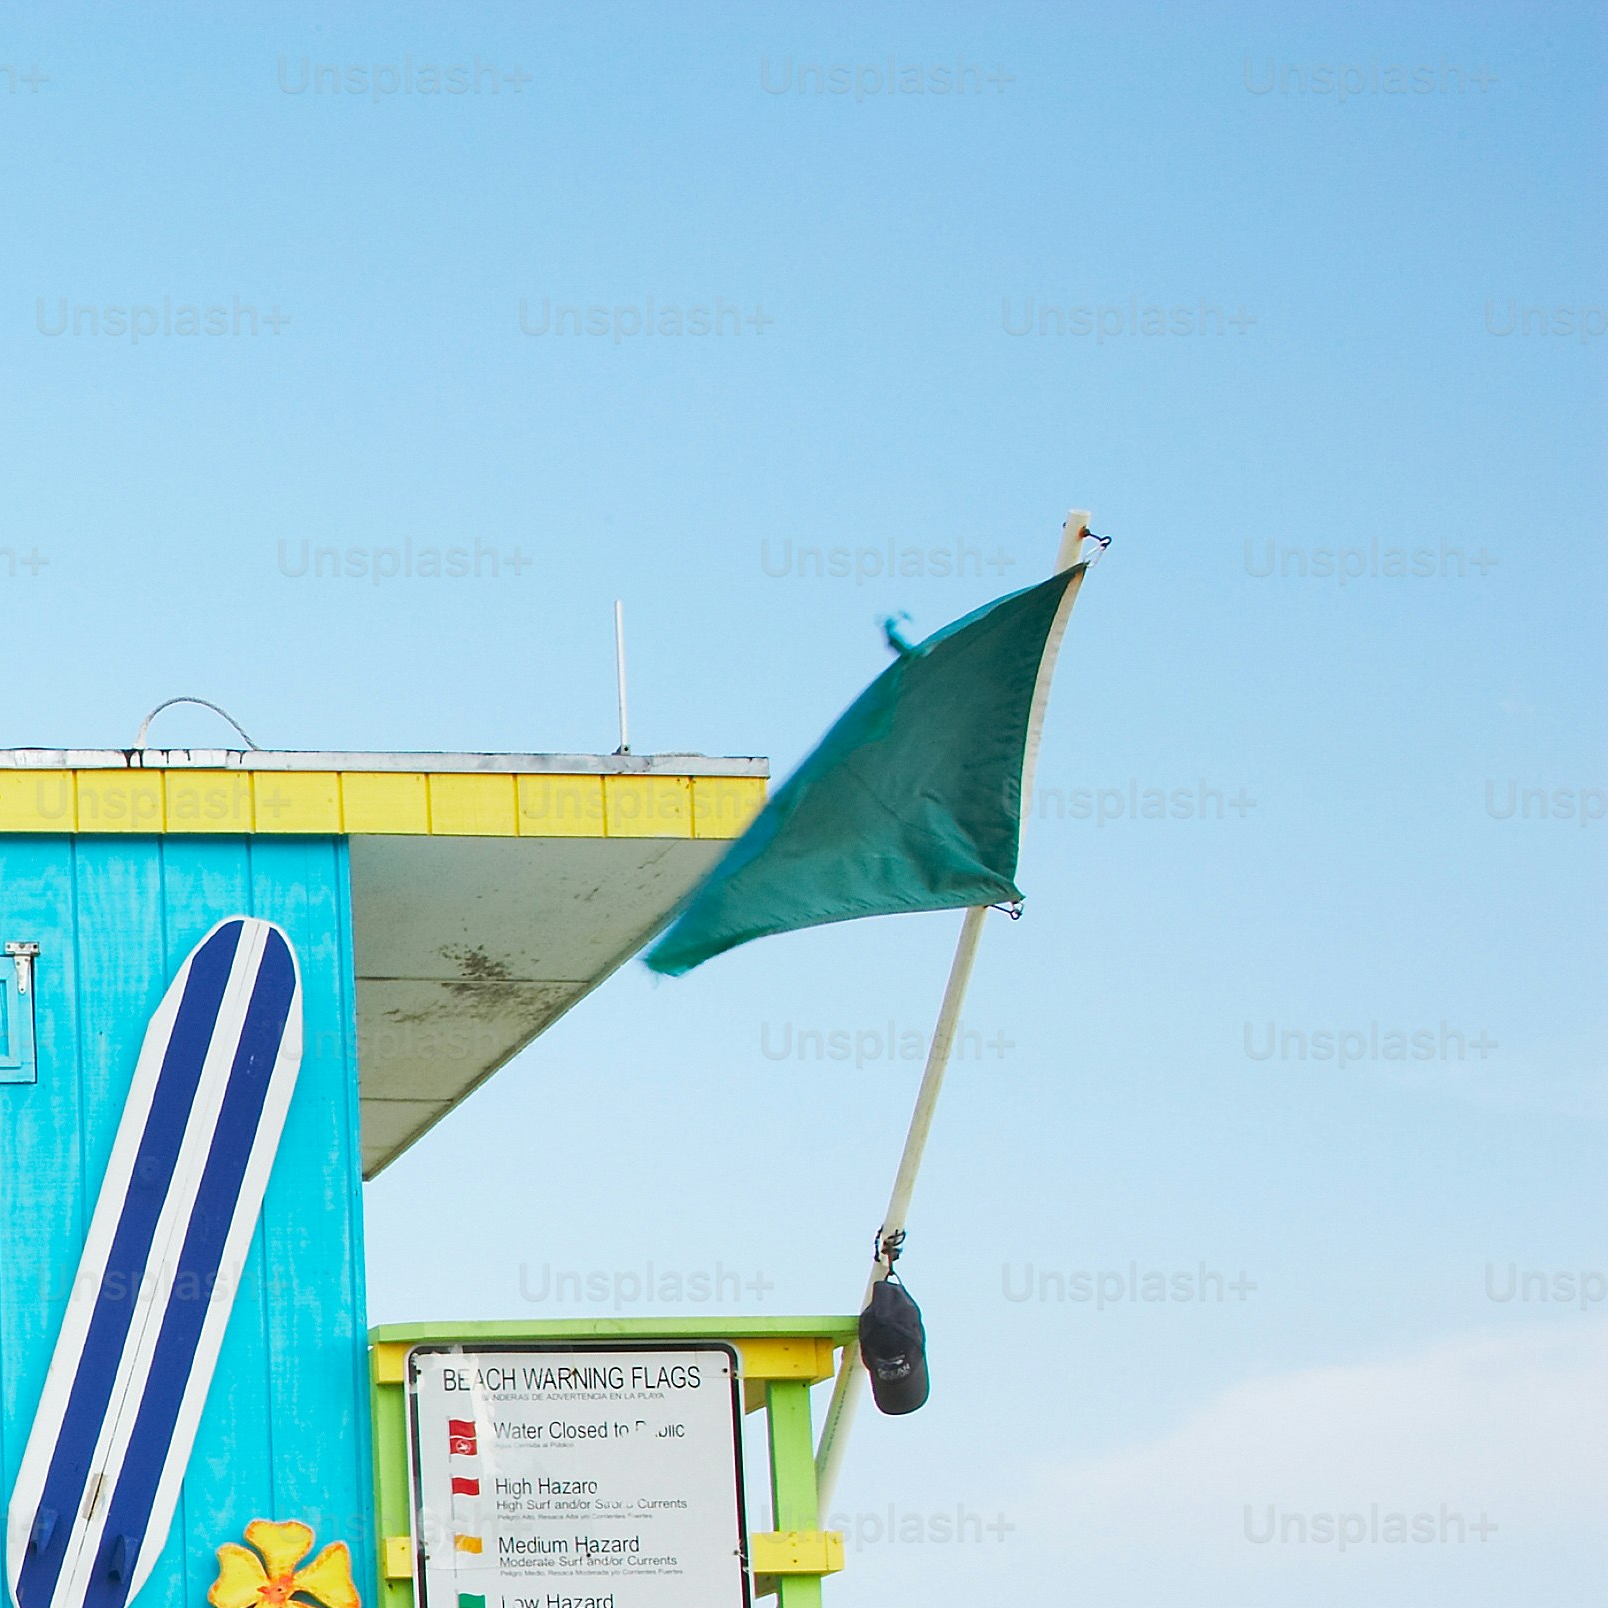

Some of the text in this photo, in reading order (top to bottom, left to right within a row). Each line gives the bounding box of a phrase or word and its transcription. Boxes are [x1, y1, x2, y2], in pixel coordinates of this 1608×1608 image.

[443, 1366, 701, 1391] BEACH WARNING FLAGS
[482, 1393, 530, 1401] NDERAS
[493, 1421, 543, 1440] Water
[548, 1421, 608, 1439] Closed
[614, 1422, 629, 1438] to
[495, 1478, 534, 1499] High
[496, 1500, 523, 1511] High
[526, 1499, 551, 1510] Surf
[554, 1499, 591, 1510] and/or
[636, 1499, 688, 1509] Currents
[498, 1536, 640, 1554] Medium Hazard
[499, 1555, 678, 1567] Moderate Surf and/or Currents
